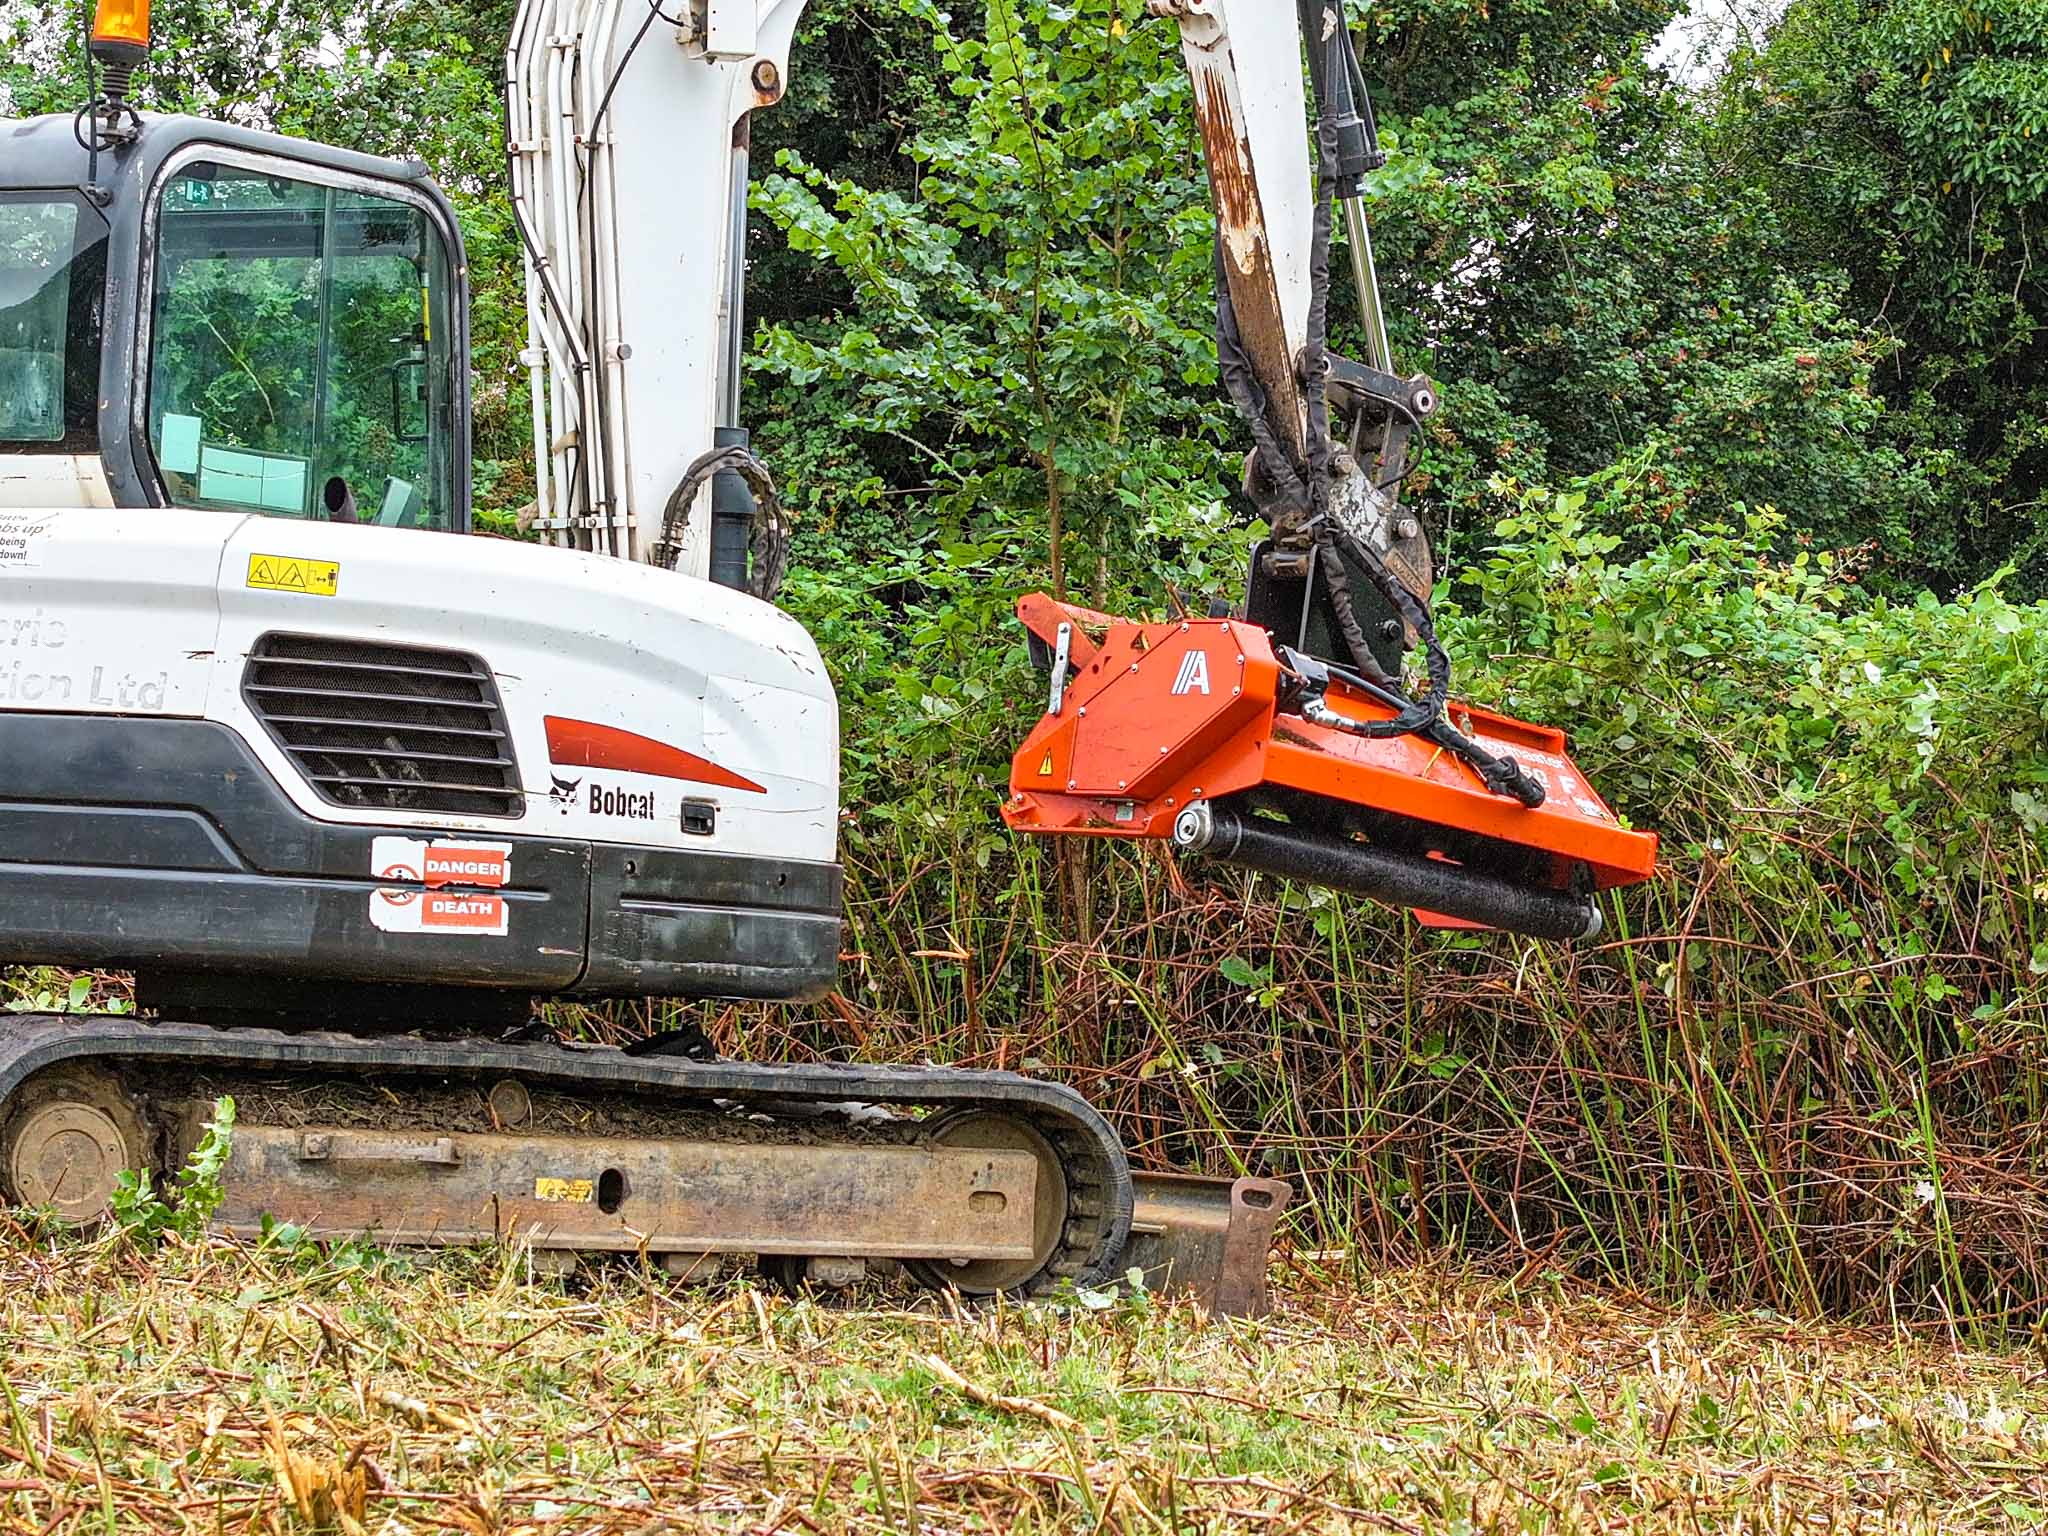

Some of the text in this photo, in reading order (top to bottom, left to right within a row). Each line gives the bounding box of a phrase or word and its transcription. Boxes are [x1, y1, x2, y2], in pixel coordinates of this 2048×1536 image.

[22, 525, 44, 537] up
[90, 665, 168, 710] Ltd
[589, 783, 655, 821] Bobcat
[426, 859, 502, 876] DANGER
[431, 900, 494, 915] DEATH
